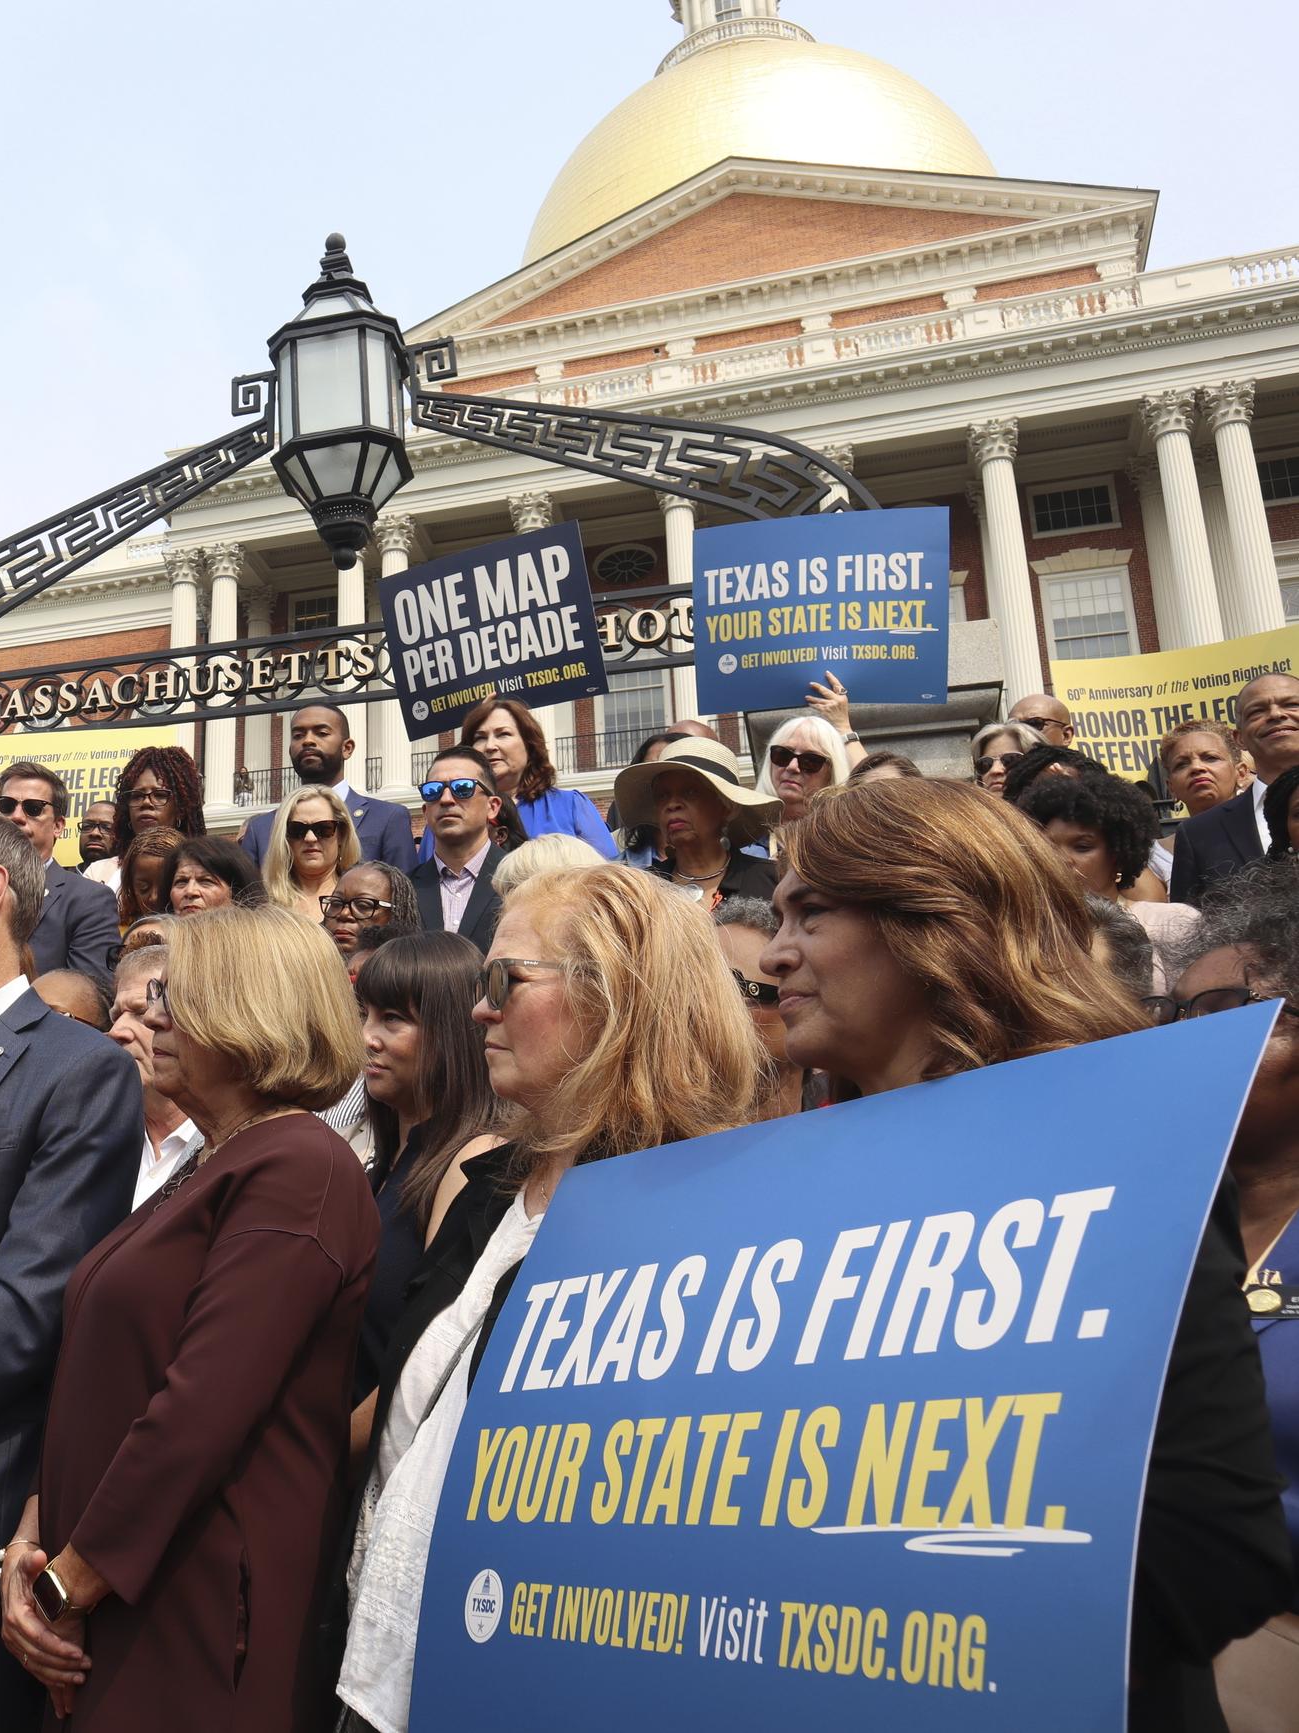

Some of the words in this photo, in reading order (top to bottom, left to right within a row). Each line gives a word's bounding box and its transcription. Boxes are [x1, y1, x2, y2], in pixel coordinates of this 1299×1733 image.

[394, 572, 470, 645] ONE
[473, 545, 571, 622] MAP
[704, 560, 790, 606] TEXAS
[798, 557, 828, 596] IS
[836, 552, 933, 592] FIRST.
[705, 609, 762, 644] YOUR
[768, 603, 831, 637] STATE
[838, 602, 862, 631] IS
[868, 600, 933, 630] NEXT.
[402, 638, 457, 694] PER
[459, 604, 585, 676] DECADE
[741, 653, 760, 669] GET
[761, 647, 818, 667] INVOLVED!
[821, 645, 848, 660] Visit
[851, 644, 919, 660] TXSDC.ORG.
[430, 695, 450, 713] GET
[449, 681, 496, 708] INVOLVED!
[498, 676, 524, 693] Visit
[525, 662, 590, 688] TXSDC.ORG.
[1089, 685, 1153, 701] Anniversary
[1156, 682, 1167, 696] of
[1171, 680, 1189, 693] the
[1192, 673, 1230, 691] Voting
[1232, 664, 1269, 683] Rights
[1272, 658, 1292, 674] Act
[1070, 708, 1149, 739] HONOR
[1150, 703, 1194, 735] THE
[10, 752, 61, 765] Anniversary
[62, 752, 71, 761] of
[72, 751, 88, 760] the
[90, 749, 118, 760] Voting
[499, 1255, 707, 1392] TEXAS
[696, 1239, 803, 1374] IS
[794, 1186, 1116, 1365] FIRST.
[466, 1423, 591, 1523] YOUR
[592, 1411, 763, 1526] STATE
[761, 1405, 841, 1528] IS
[845, 1392, 1067, 1531] NEXT.
[472, 1598, 496, 1614] TXSDC
[509, 1582, 552, 1637] GET
[552, 1585, 689, 1655] INVOLVED!
[700, 1596, 768, 1664] Visit
[778, 1601, 997, 1693] TXSDC.ORG.
